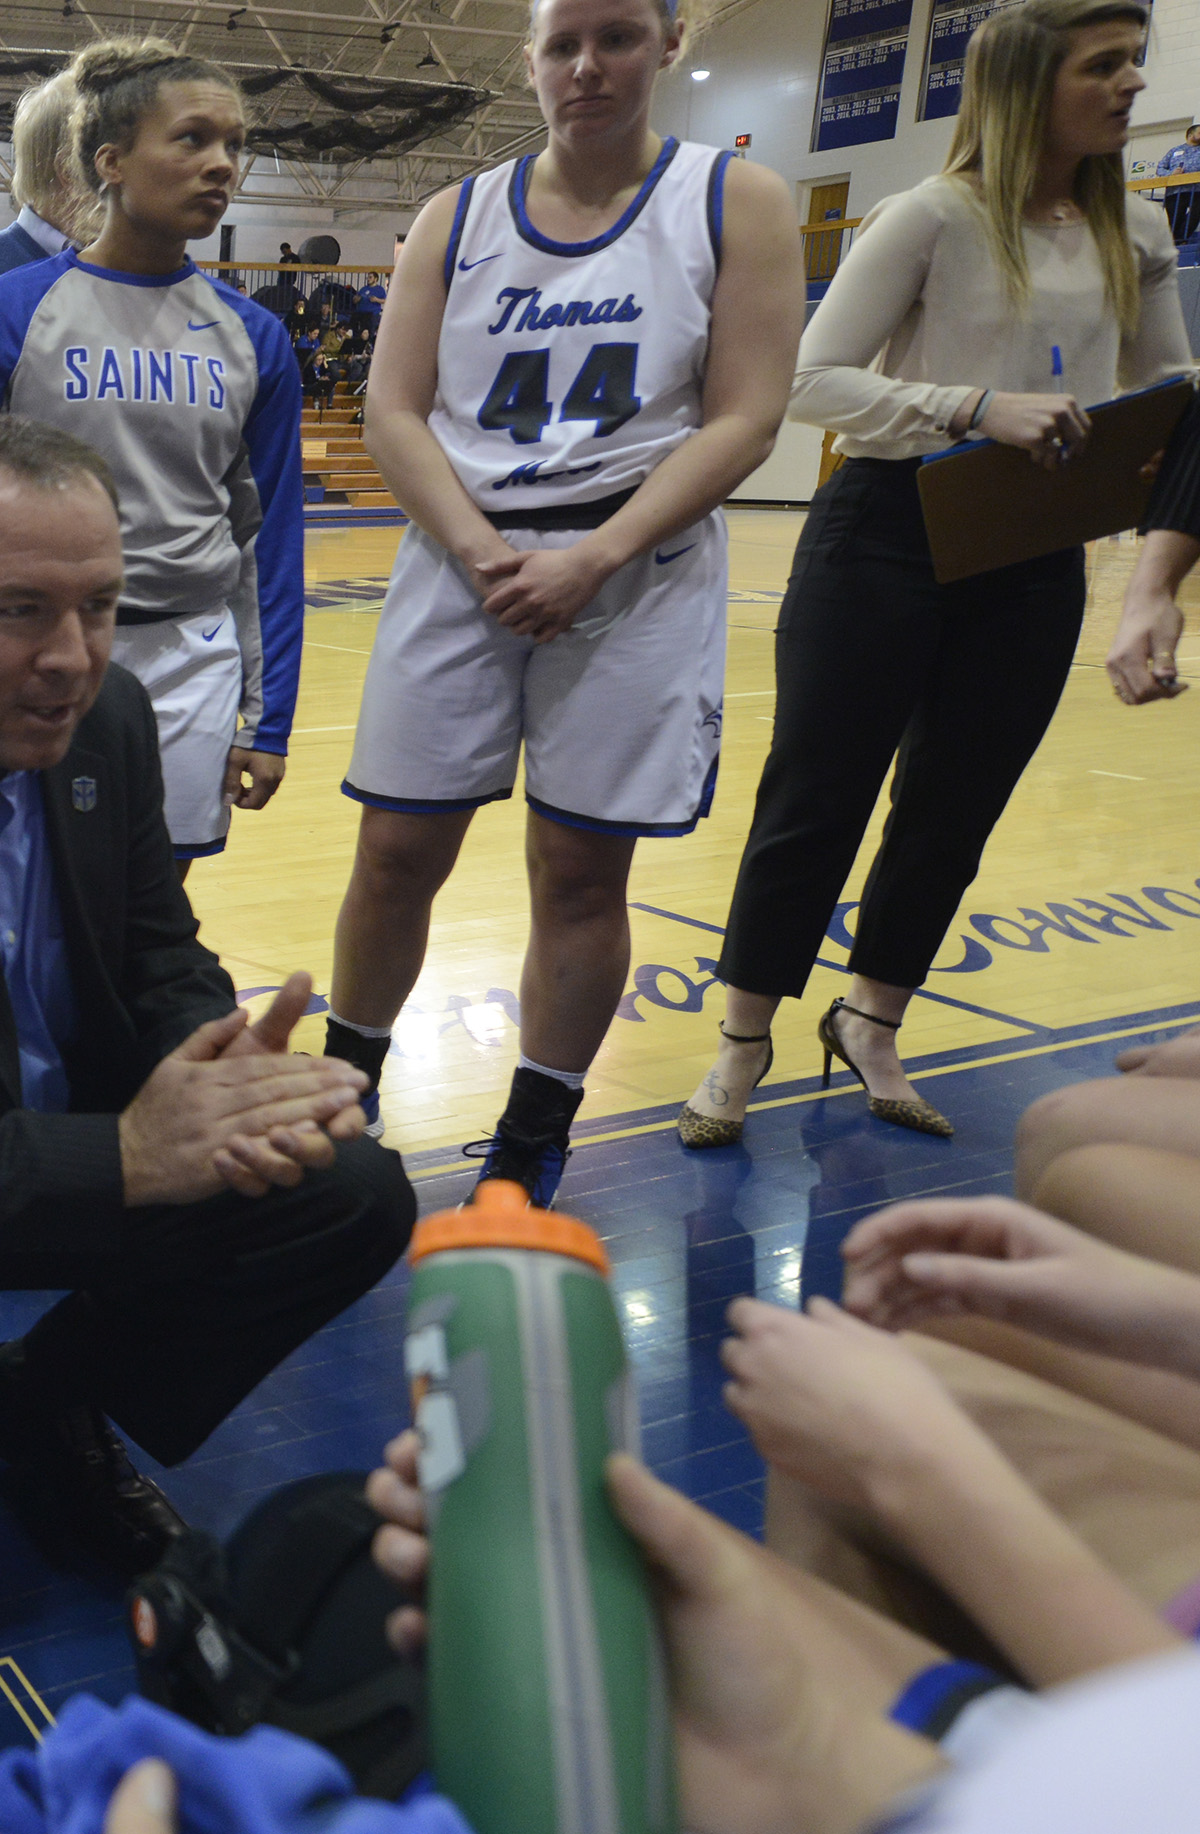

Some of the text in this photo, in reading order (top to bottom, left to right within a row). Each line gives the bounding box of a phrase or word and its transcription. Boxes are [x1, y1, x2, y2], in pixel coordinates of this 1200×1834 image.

[487, 286, 644, 335] Thomas
[63, 345, 228, 411] SAINTS
[477, 341, 641, 445] 44
